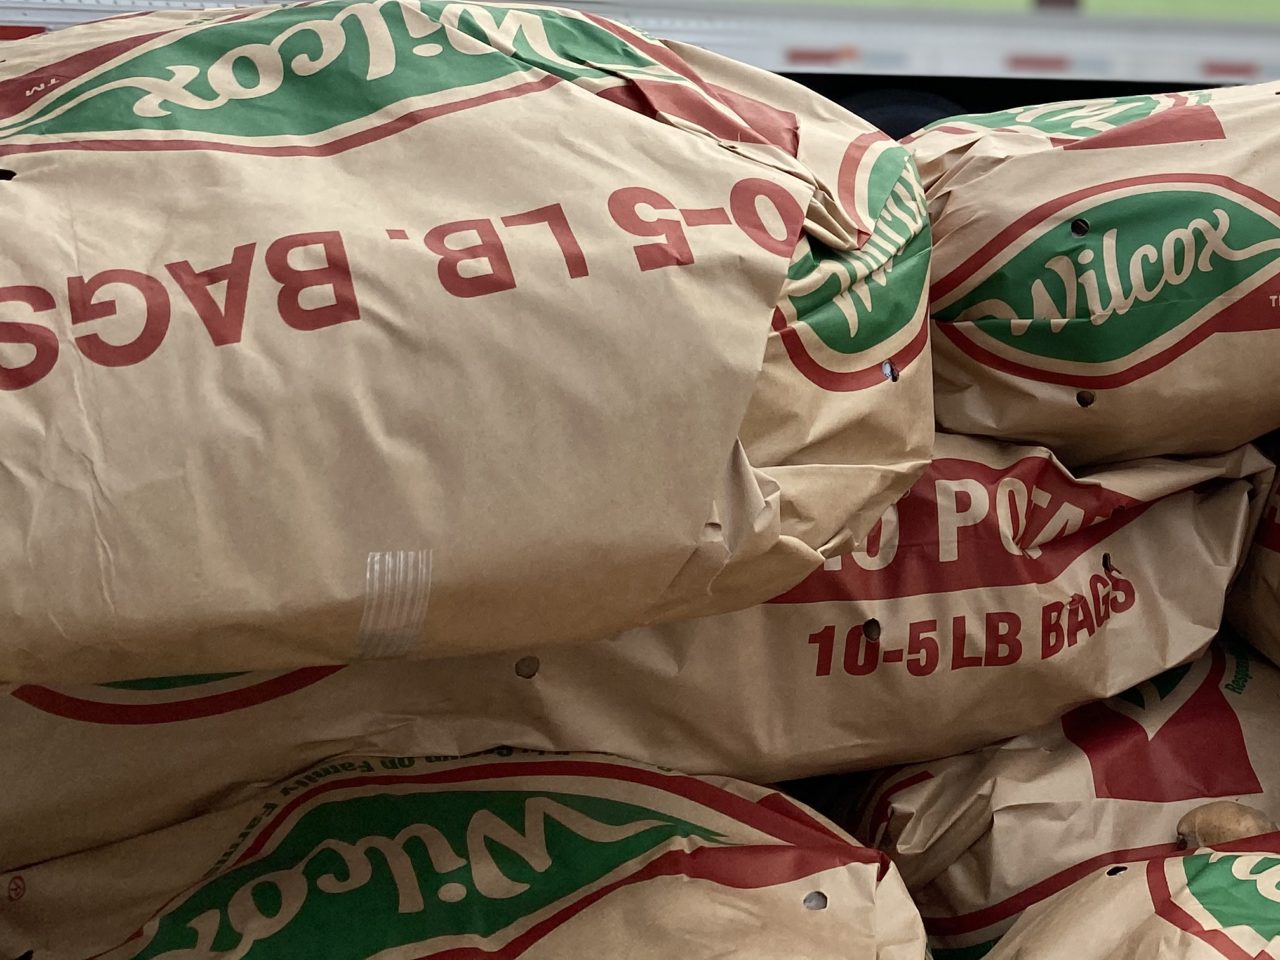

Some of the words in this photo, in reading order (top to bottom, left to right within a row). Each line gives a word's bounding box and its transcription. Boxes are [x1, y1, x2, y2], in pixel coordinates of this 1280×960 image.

[0, 229, 361, 391] BAGS
[955, 208, 1240, 336] Wilcox
[808, 619, 939, 678] 10-5
[951, 611, 1023, 671] LB
[1040, 566, 1137, 660] BAGS
